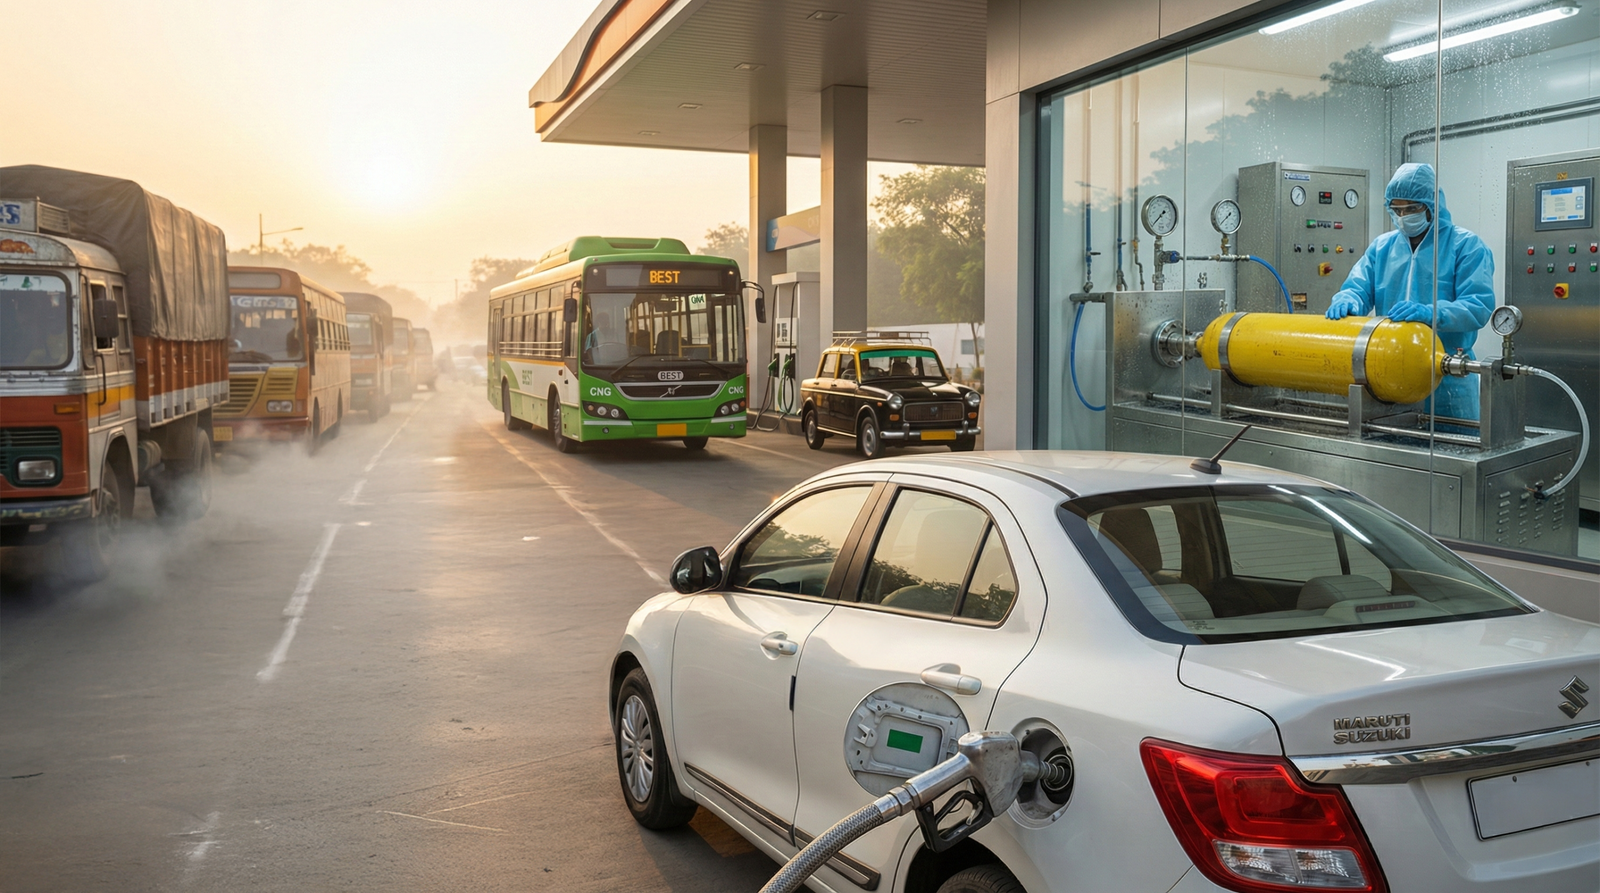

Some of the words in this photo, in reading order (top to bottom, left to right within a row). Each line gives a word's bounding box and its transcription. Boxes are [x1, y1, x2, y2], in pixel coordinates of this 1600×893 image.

[650, 270, 680, 284] BEST
[660, 371, 682, 380] BEST
[590, 387, 611, 397] CNG
[728, 385, 744, 395] CNG
[1333, 713, 1411, 730] MARUTI
[1333, 727, 1411, 745] SUZUKI
